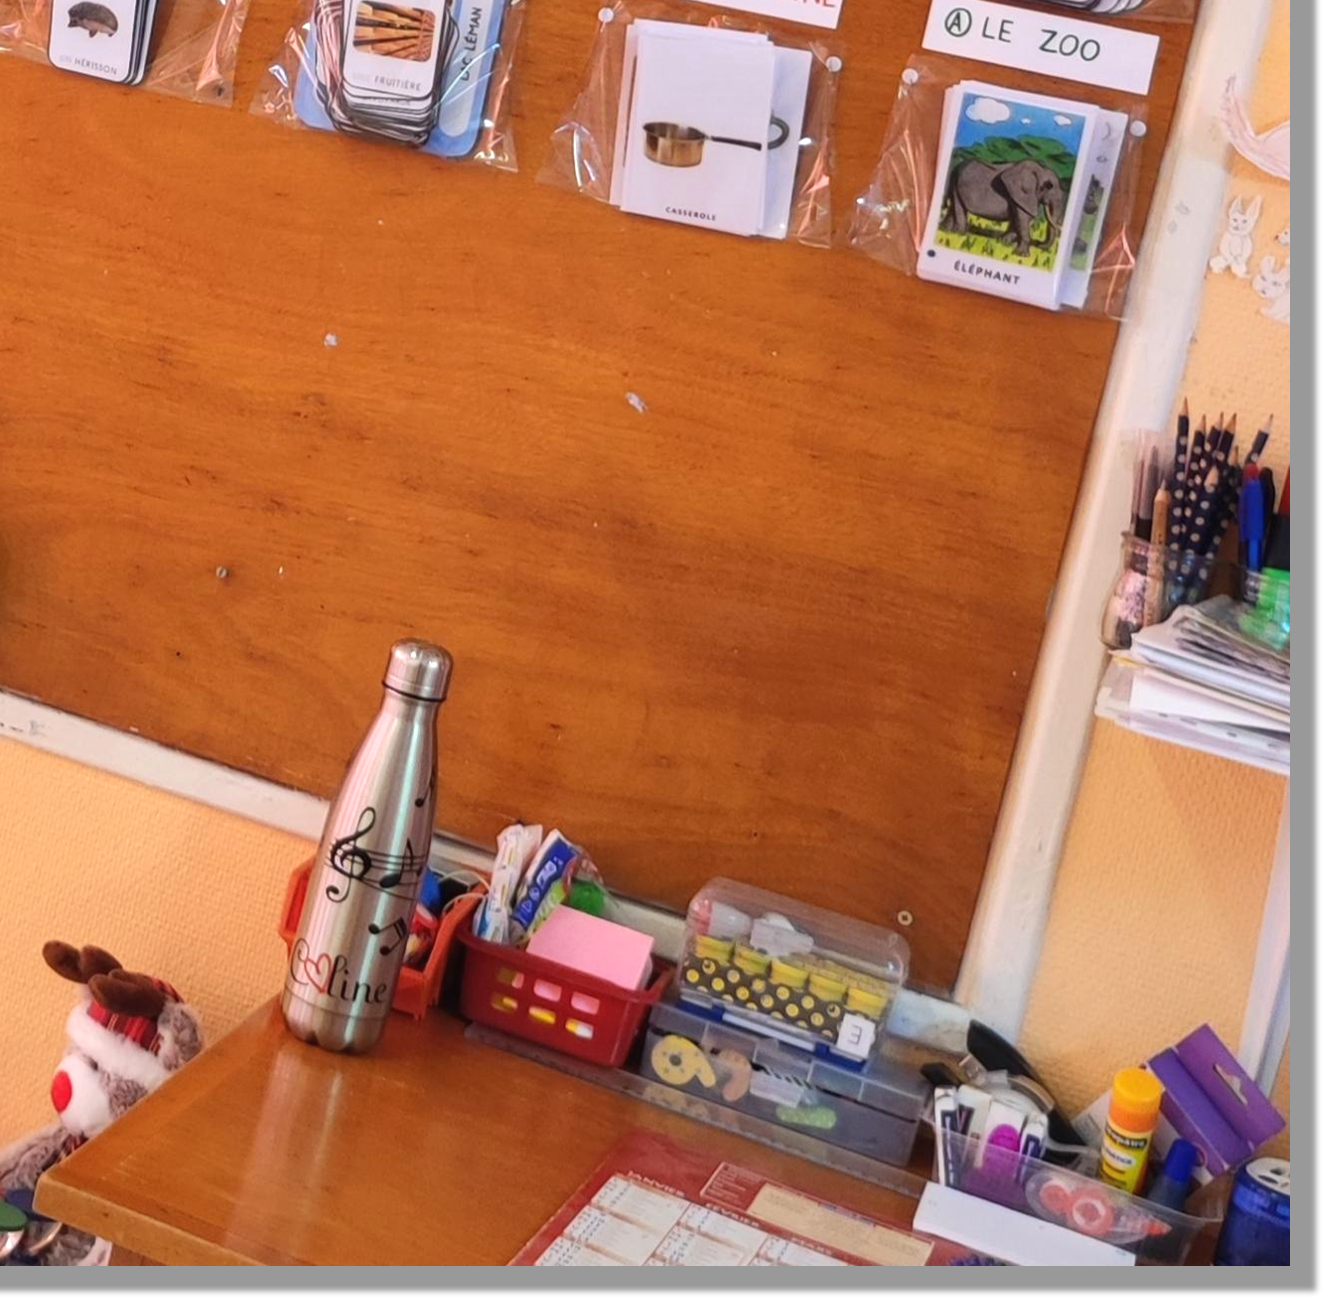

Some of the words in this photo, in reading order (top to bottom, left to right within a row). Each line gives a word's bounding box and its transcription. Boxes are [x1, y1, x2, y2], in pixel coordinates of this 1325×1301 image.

[466, 7, 483, 52] LÉMAN
[982, 16, 1014, 43] LE
[1038, 29, 1101, 62] ZOO
[74, 56, 118, 76] HÉRISSON
[375, 76, 421, 91] FRUITIÈRE
[665, 206, 717, 221] CASSEROLE
[953, 260, 1021, 285] ÉLÉPHANT
